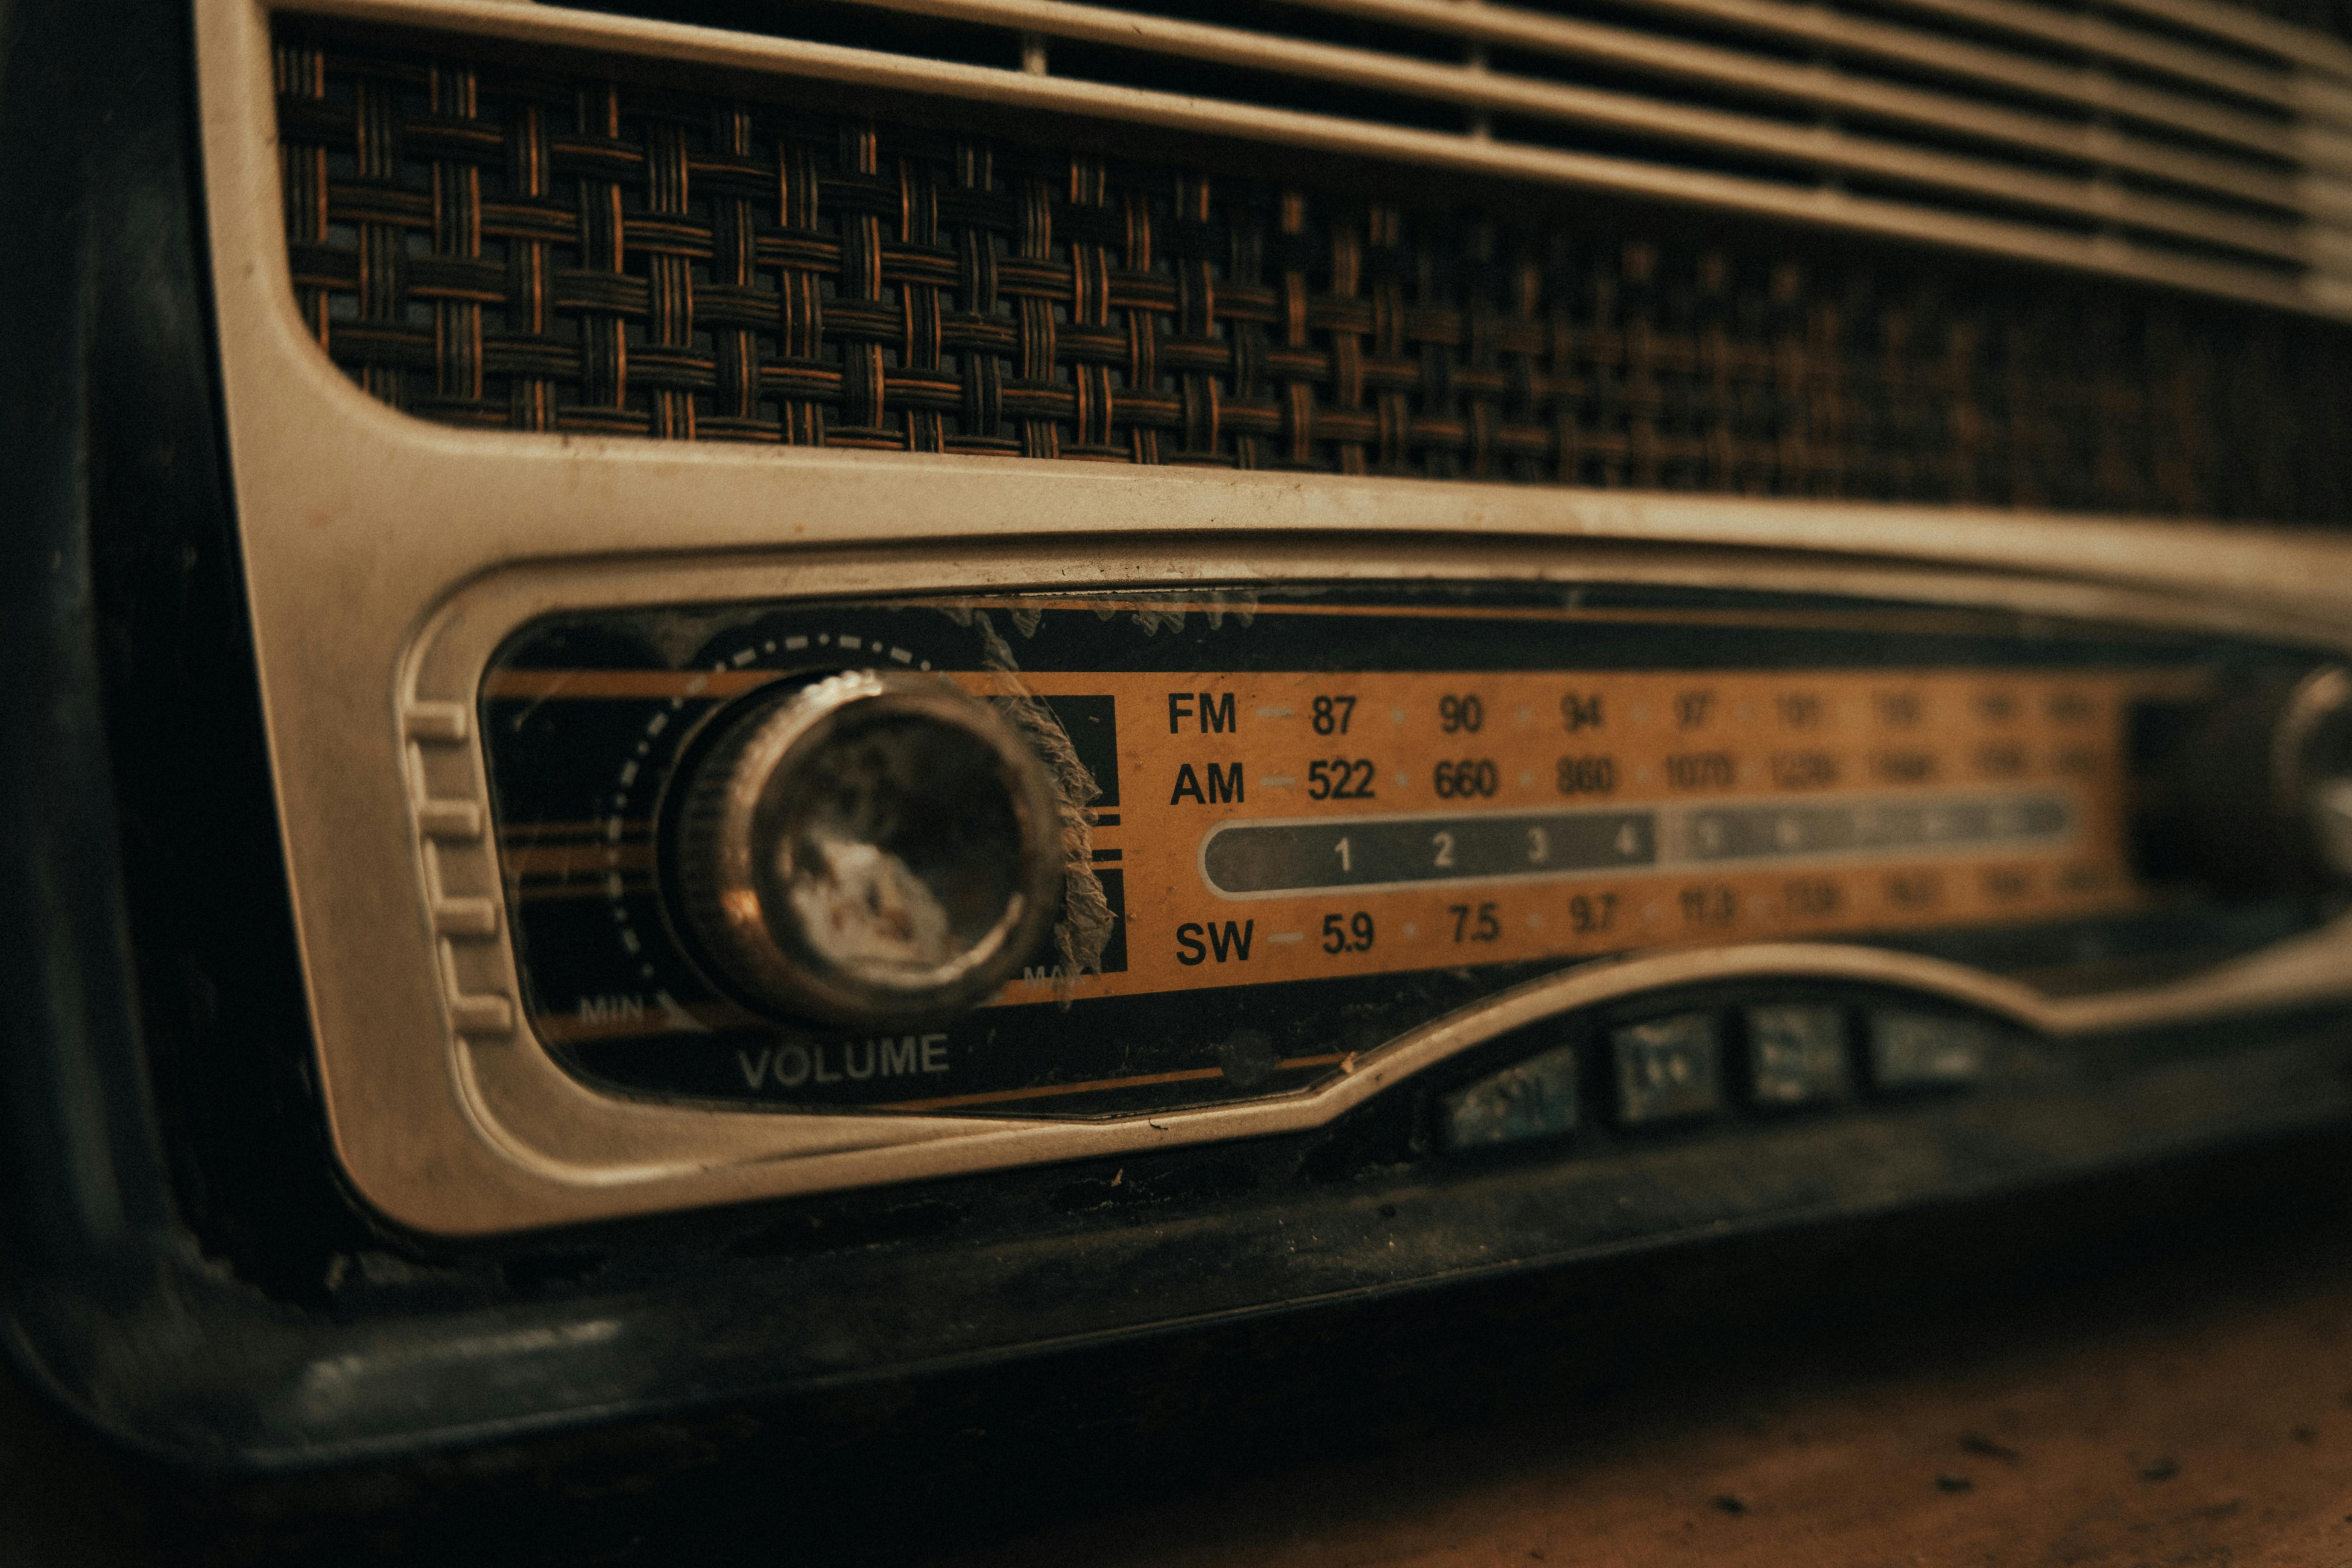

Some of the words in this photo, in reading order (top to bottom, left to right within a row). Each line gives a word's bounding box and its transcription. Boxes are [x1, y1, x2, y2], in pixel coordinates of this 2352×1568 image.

[1168, 692, 1236, 734] FM
[1312, 695, 1357, 736] 87
[1439, 694, 1484, 734] 90
[1561, 694, 1603, 733] 94
[1170, 762, 1244, 805] AM
[1308, 758, 1375, 801] 522
[1433, 759, 1499, 799] 660
[1335, 838, 1350, 871] 1
[1433, 832, 1453, 867] 2
[1529, 828, 1548, 861] 3
[1176, 920, 1254, 966] SW
[1323, 912, 1375, 956] 5.9
[1449, 902, 1501, 943] 7.5
[580, 996, 643, 1023] MIN
[737, 1034, 948, 1088] VOLUME
